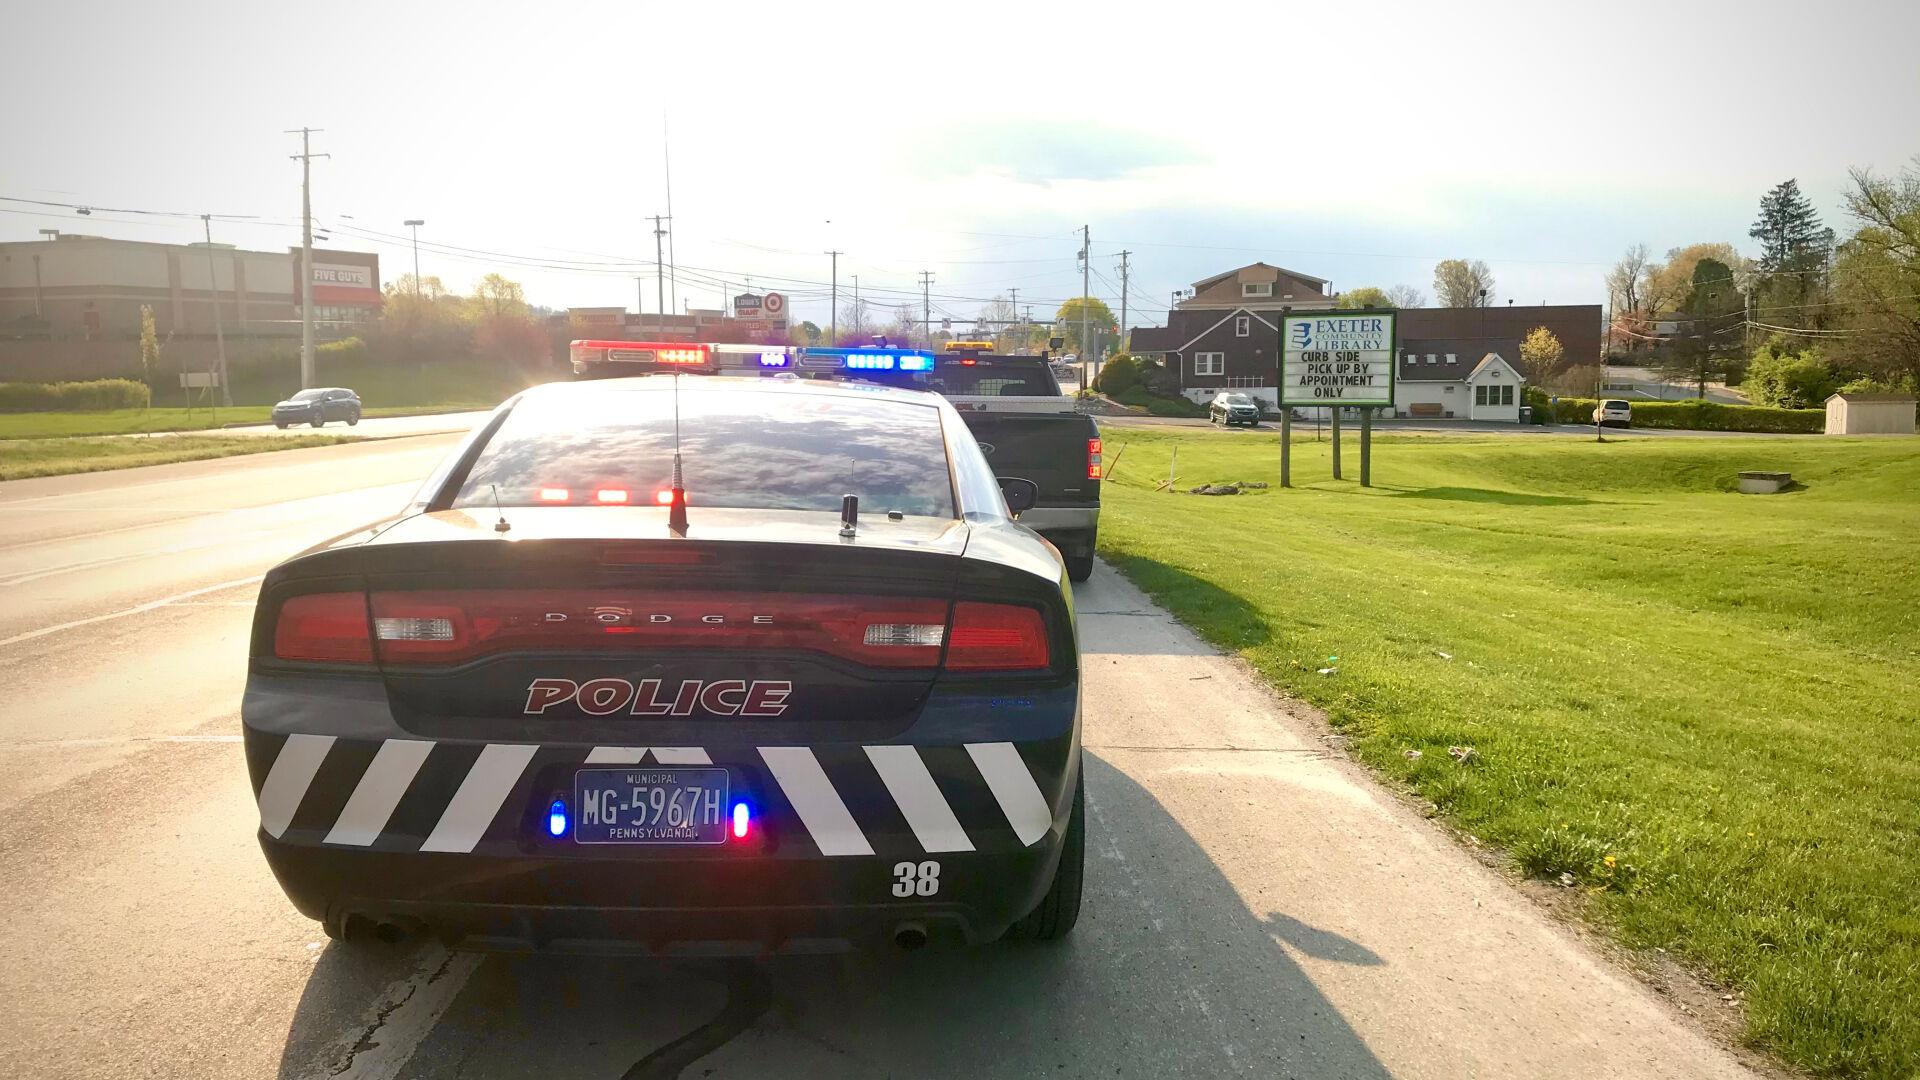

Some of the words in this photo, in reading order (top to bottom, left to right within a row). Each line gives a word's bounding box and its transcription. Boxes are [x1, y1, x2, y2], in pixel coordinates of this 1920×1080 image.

[314, 270, 336, 281] FIVE
[337, 271, 364, 282] GUYS
[1316, 319, 1382, 332] EXETER
[1315, 340, 1383, 350] LIBRARY
[1301, 352, 1329, 362] CURB
[1335, 352, 1360, 362] SIDE
[1307, 364, 1333, 374] PICK
[1336, 364, 1350, 374] UP
[1353, 364, 1369, 374] BY
[1300, 375, 1374, 386] APPOINTMENT
[1314, 387, 1344, 398] ONLY
[546, 613, 773, 624] DODGE
[524, 678, 792, 716] POLICE
[626, 774, 678, 785] MUNICIPAL
[582, 787, 721, 827] MG-5967H
[609, 828, 692, 839] PENNSYLVANIA
[891, 860, 941, 898] 38
